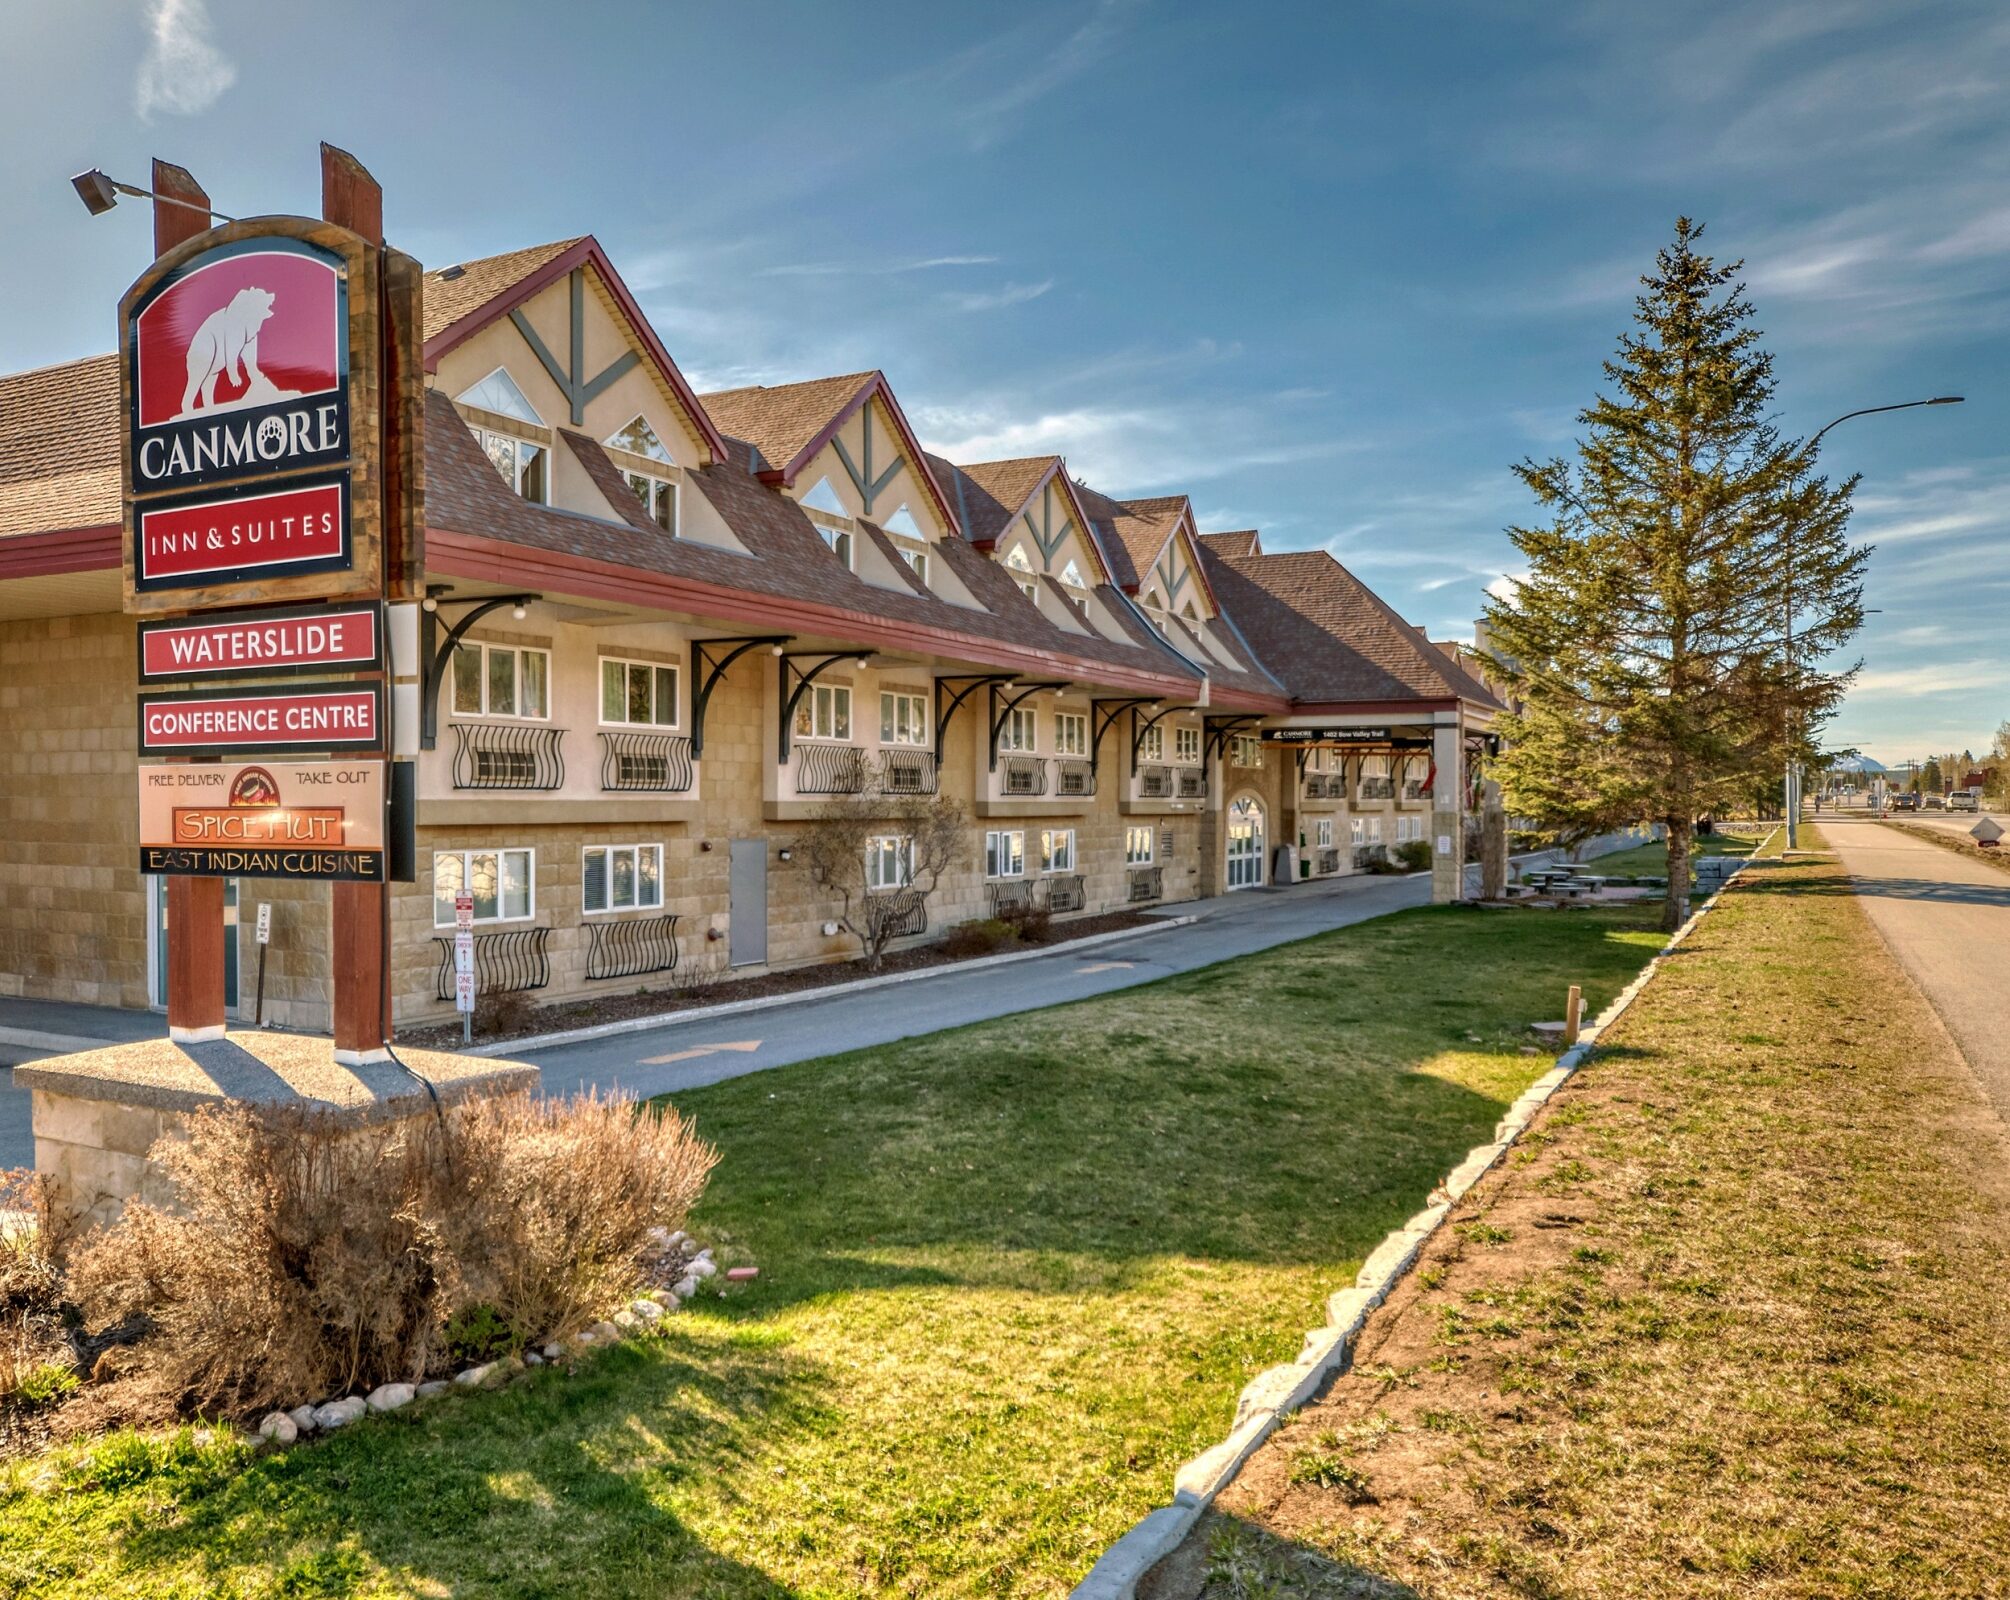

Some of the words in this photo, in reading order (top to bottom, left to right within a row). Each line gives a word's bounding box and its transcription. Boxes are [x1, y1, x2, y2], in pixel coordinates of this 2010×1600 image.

[139, 404, 341, 479] CANMORE
[152, 531, 198, 556] INN
[231, 513, 332, 543] SUITES
[170, 623, 344, 664] WATERSLIDE
[149, 709, 278, 735] CONFERENCE
[285, 705, 368, 730] CENTRE
[1352, 730, 1370, 739] Valley
[148, 775, 174, 786] FREE
[178, 773, 226, 786] DELIVERY
[296, 772, 332, 785] TAKE
[336, 771, 370, 784] OUT
[180, 813, 263, 839] SPICE
[268, 812, 336, 839] HUT
[150, 851, 203, 870] EAST
[208, 853, 278, 872] INDIAN
[283, 854, 374, 875] CUISINE
[458, 976, 472, 984] ONE
[459, 985, 472, 993] WAY
